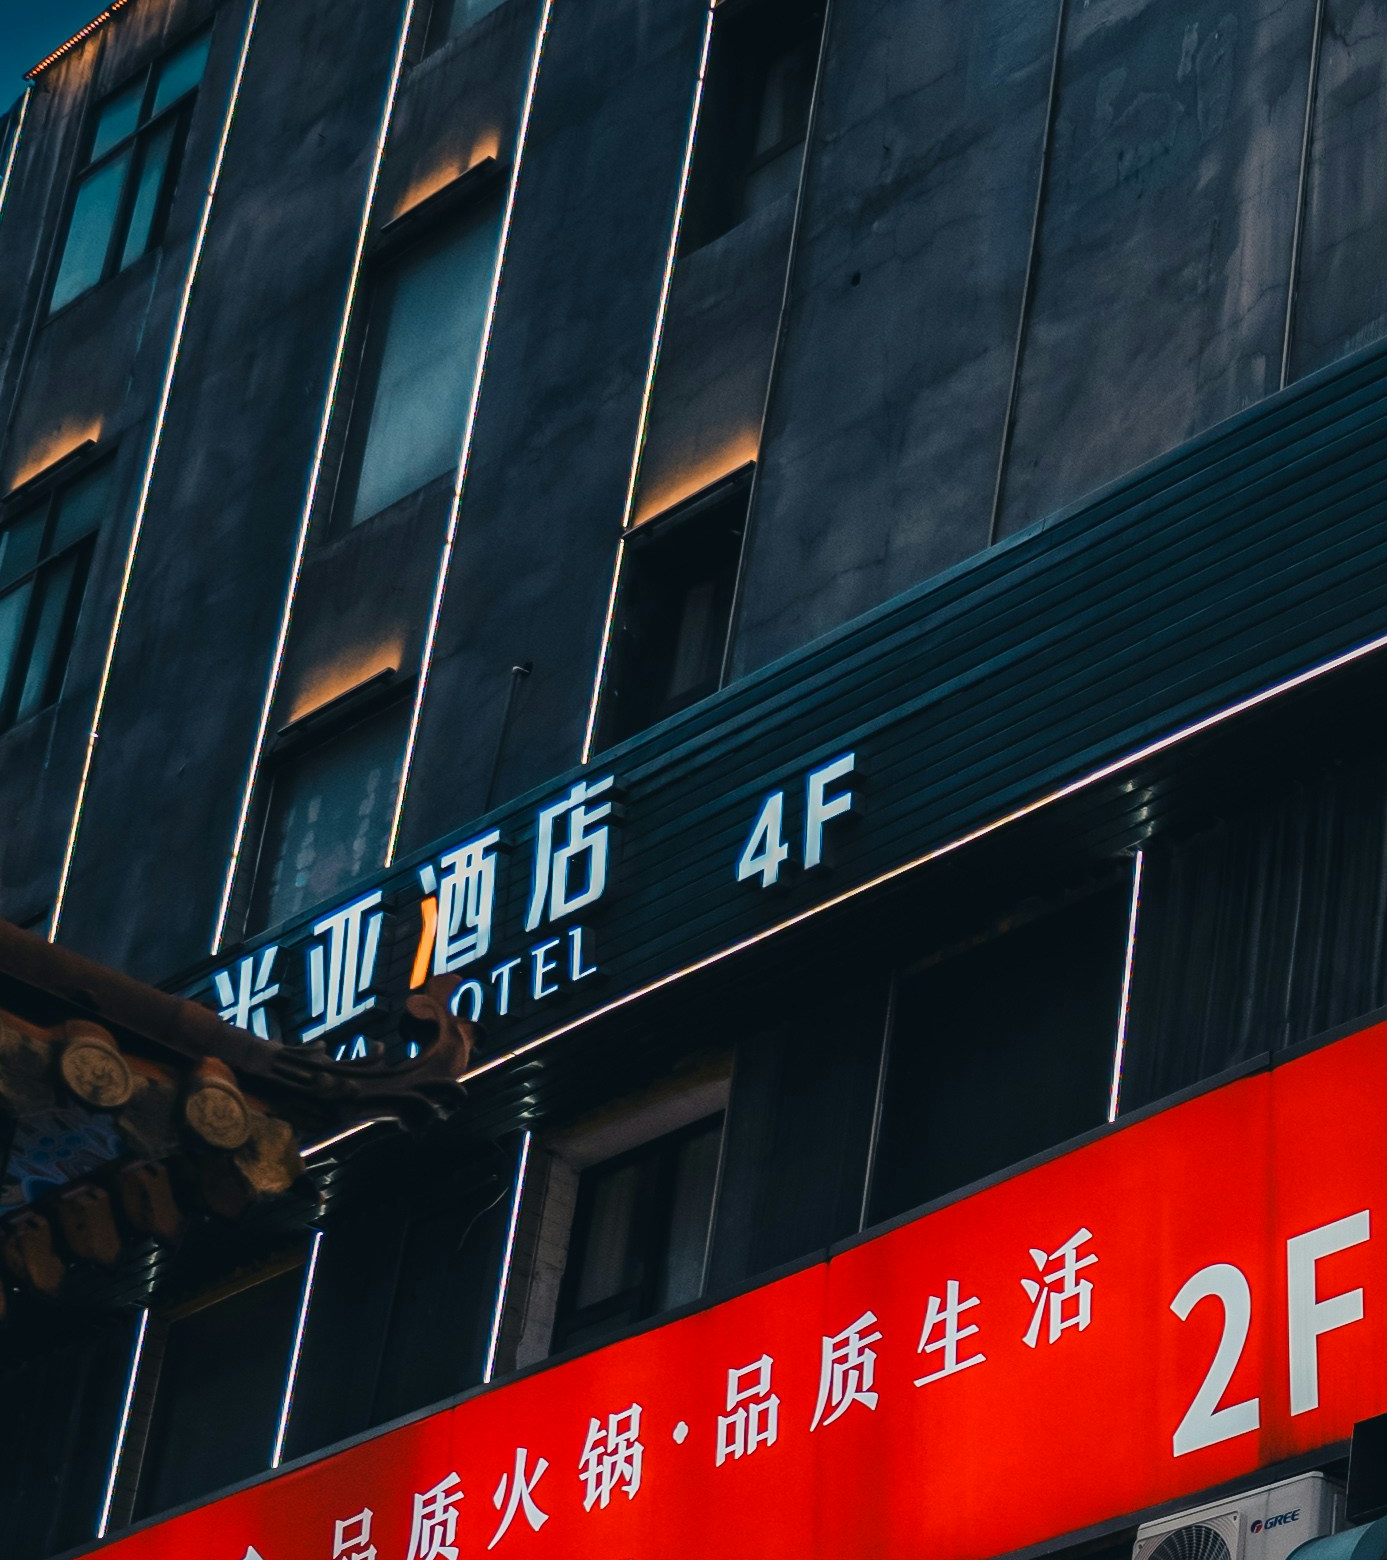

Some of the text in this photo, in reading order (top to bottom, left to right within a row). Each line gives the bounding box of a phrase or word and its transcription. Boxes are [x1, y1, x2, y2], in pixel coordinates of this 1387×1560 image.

[737, 752, 858, 888] 4F
[1170, 1210, 1371, 1458] 2F
[1264, 1508, 1300, 1530] GREE
